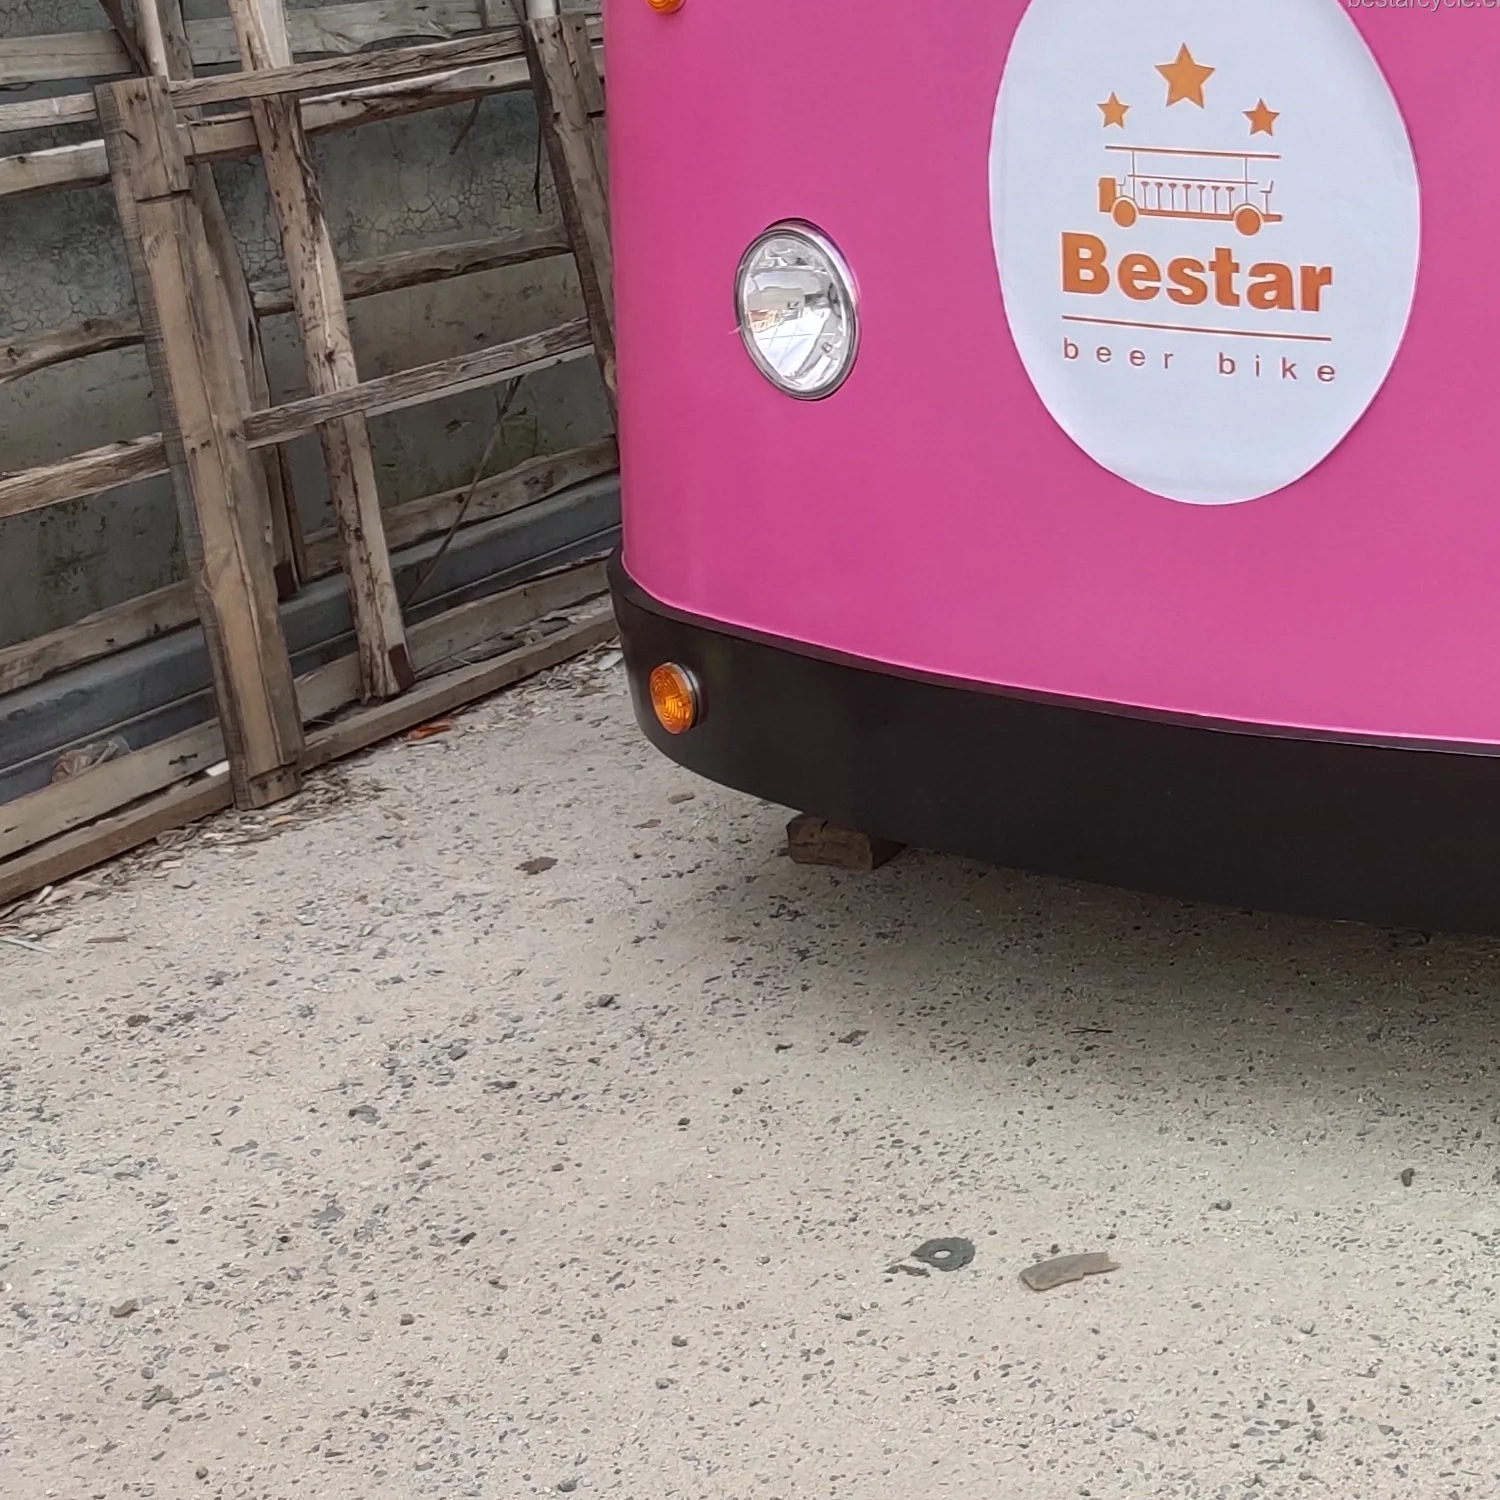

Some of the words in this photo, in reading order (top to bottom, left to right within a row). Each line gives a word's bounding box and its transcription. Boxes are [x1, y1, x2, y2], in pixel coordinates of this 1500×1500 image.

[1061, 231, 1333, 312] Bestar
[1063, 337, 1174, 370] beer
[1218, 351, 1336, 382] bike
